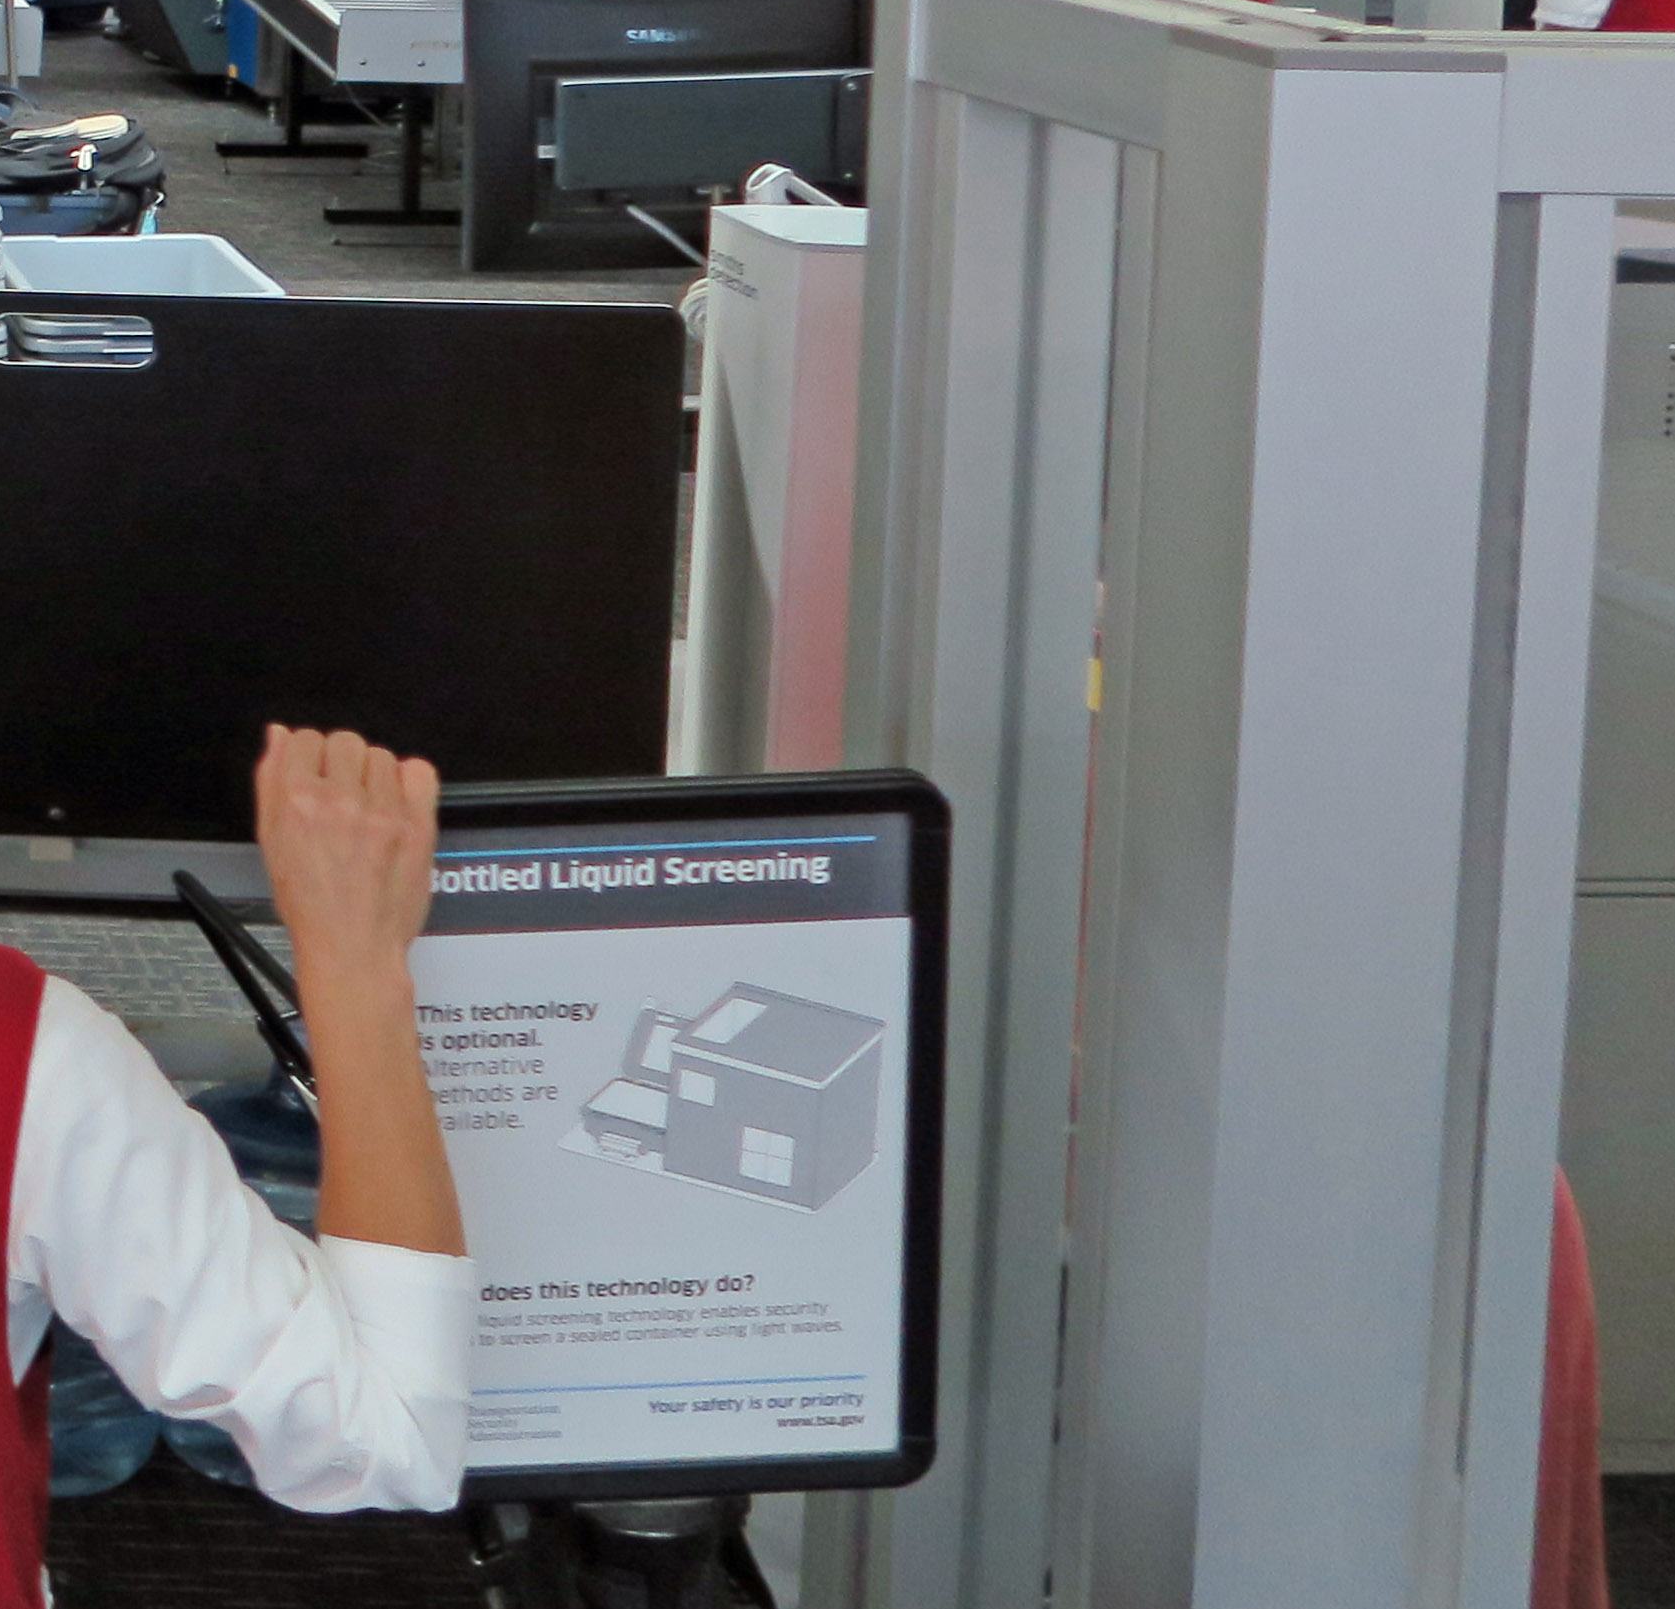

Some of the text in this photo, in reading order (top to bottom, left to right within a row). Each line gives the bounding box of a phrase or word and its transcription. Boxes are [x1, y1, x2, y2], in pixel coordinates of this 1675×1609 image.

[551, 857, 655, 892] Liquid
[663, 852, 831, 886] Screening
[416, 1000, 599, 1023] This technology
[441, 1028, 543, 1052] optional.
[430, 1084, 558, 1104] ethods are
[441, 1110, 525, 1131] ailable.
[481, 1274, 754, 1301] does this technology do?
[526, 1311, 603, 1326] screening
[608, 1308, 695, 1323] technology
[701, 1305, 760, 1319] enables
[765, 1302, 828, 1317] security
[479, 1334, 494, 1346] to
[500, 1333, 550, 1345] screen
[556, 1332, 566, 1343] a
[570, 1330, 620, 1343] sealed
[625, 1327, 700, 1341] container
[705, 1325, 748, 1338] using
[752, 1322, 786, 1337] light
[648, 1392, 864, 1413] Your safety is our priority
[776, 1415, 864, 1428] www.tsa.gov
